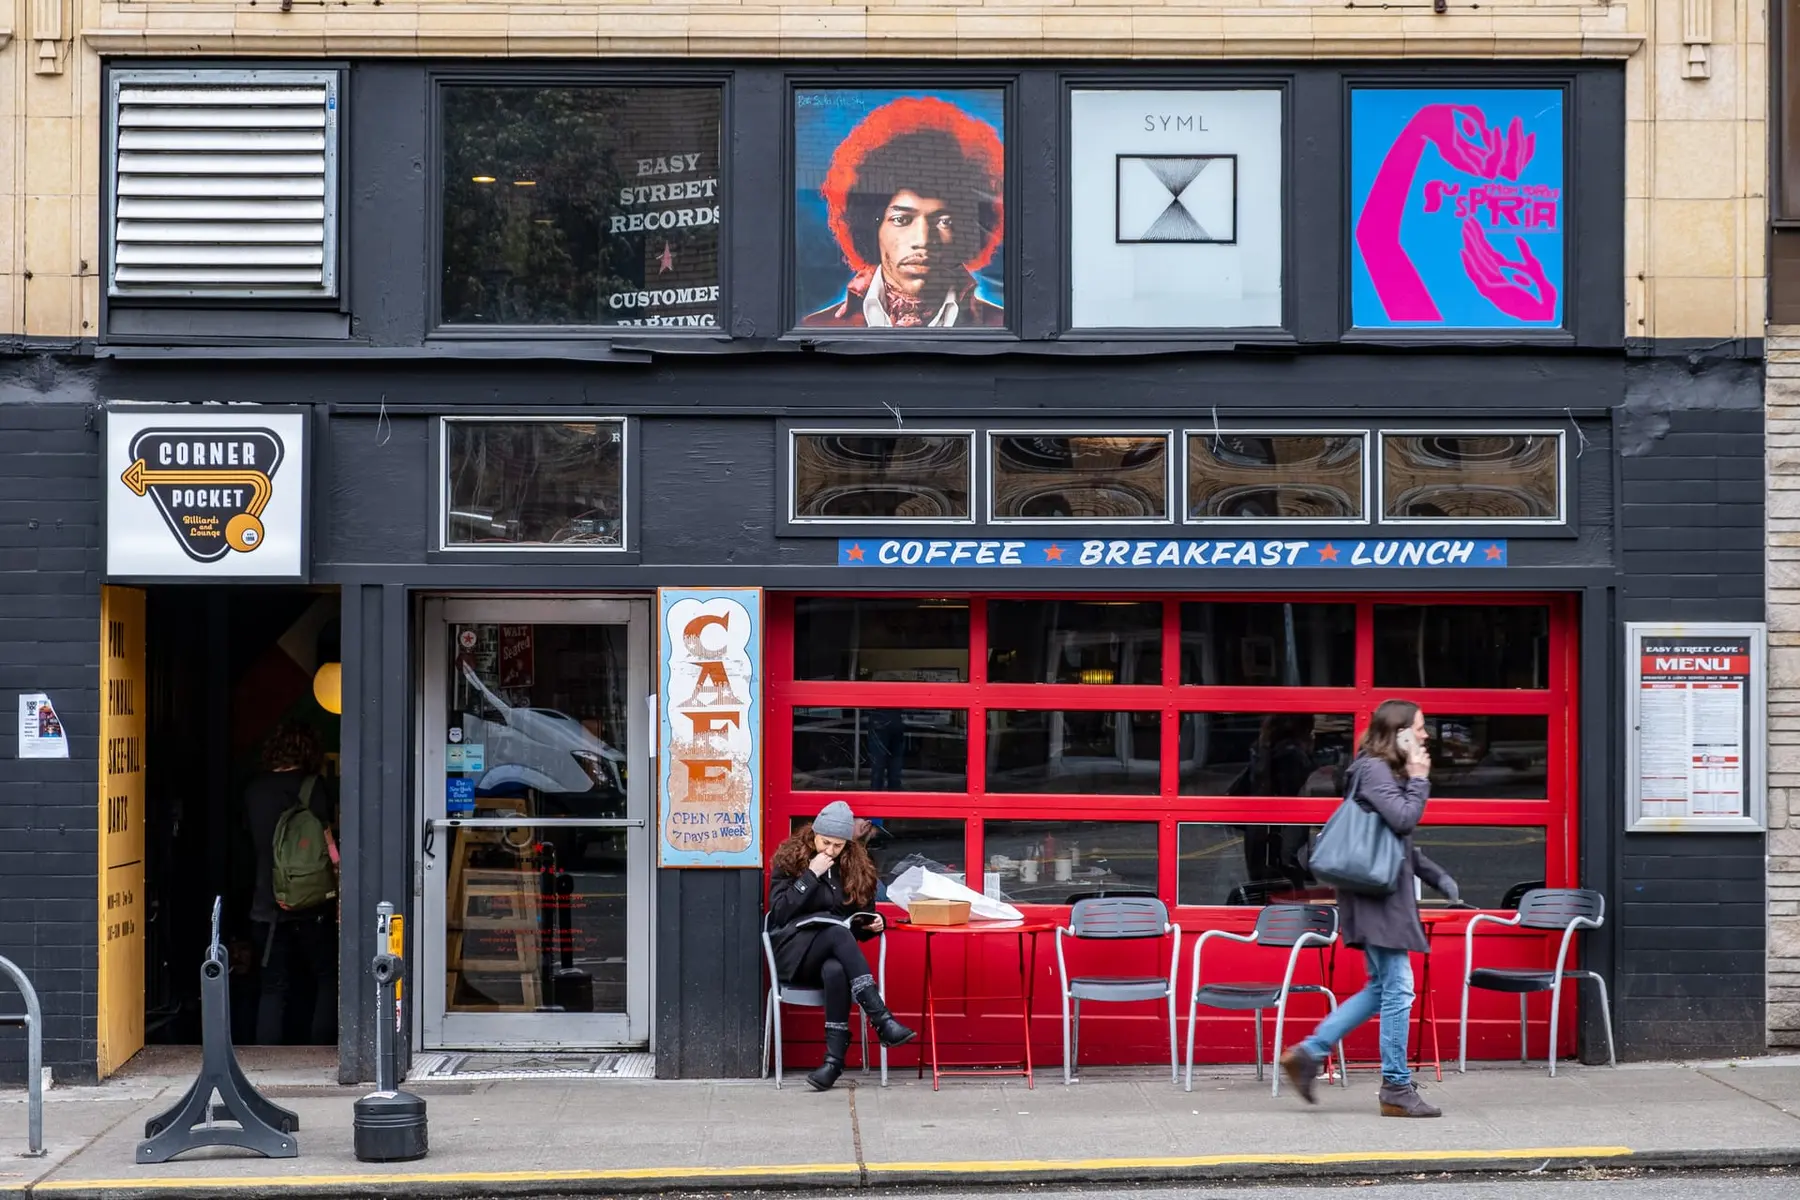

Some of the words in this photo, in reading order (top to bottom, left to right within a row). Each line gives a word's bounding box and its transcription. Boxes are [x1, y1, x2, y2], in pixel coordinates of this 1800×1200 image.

[1144, 114, 1209, 132] SYML
[636, 152, 701, 177] EASY
[619, 178, 717, 206] STREET
[159, 442, 256, 466] CORNER
[171, 489, 244, 508] POCKET
[182, 515, 220, 525] Billiards
[189, 528, 221, 539] Lounge
[878, 540, 1026, 566] COFFEE
[1078, 540, 1310, 567] BREAKFAST
[1350, 540, 1475, 567] LUNCH
[1673, 646, 1711, 654] STREET
[1655, 657, 1730, 671] MENU
[676, 610, 745, 803] CAFE
[672, 812, 710, 824] OPEN
[672, 829, 682, 839] 7
[684, 831, 710, 843] Days
[720, 825, 747, 837] Week
